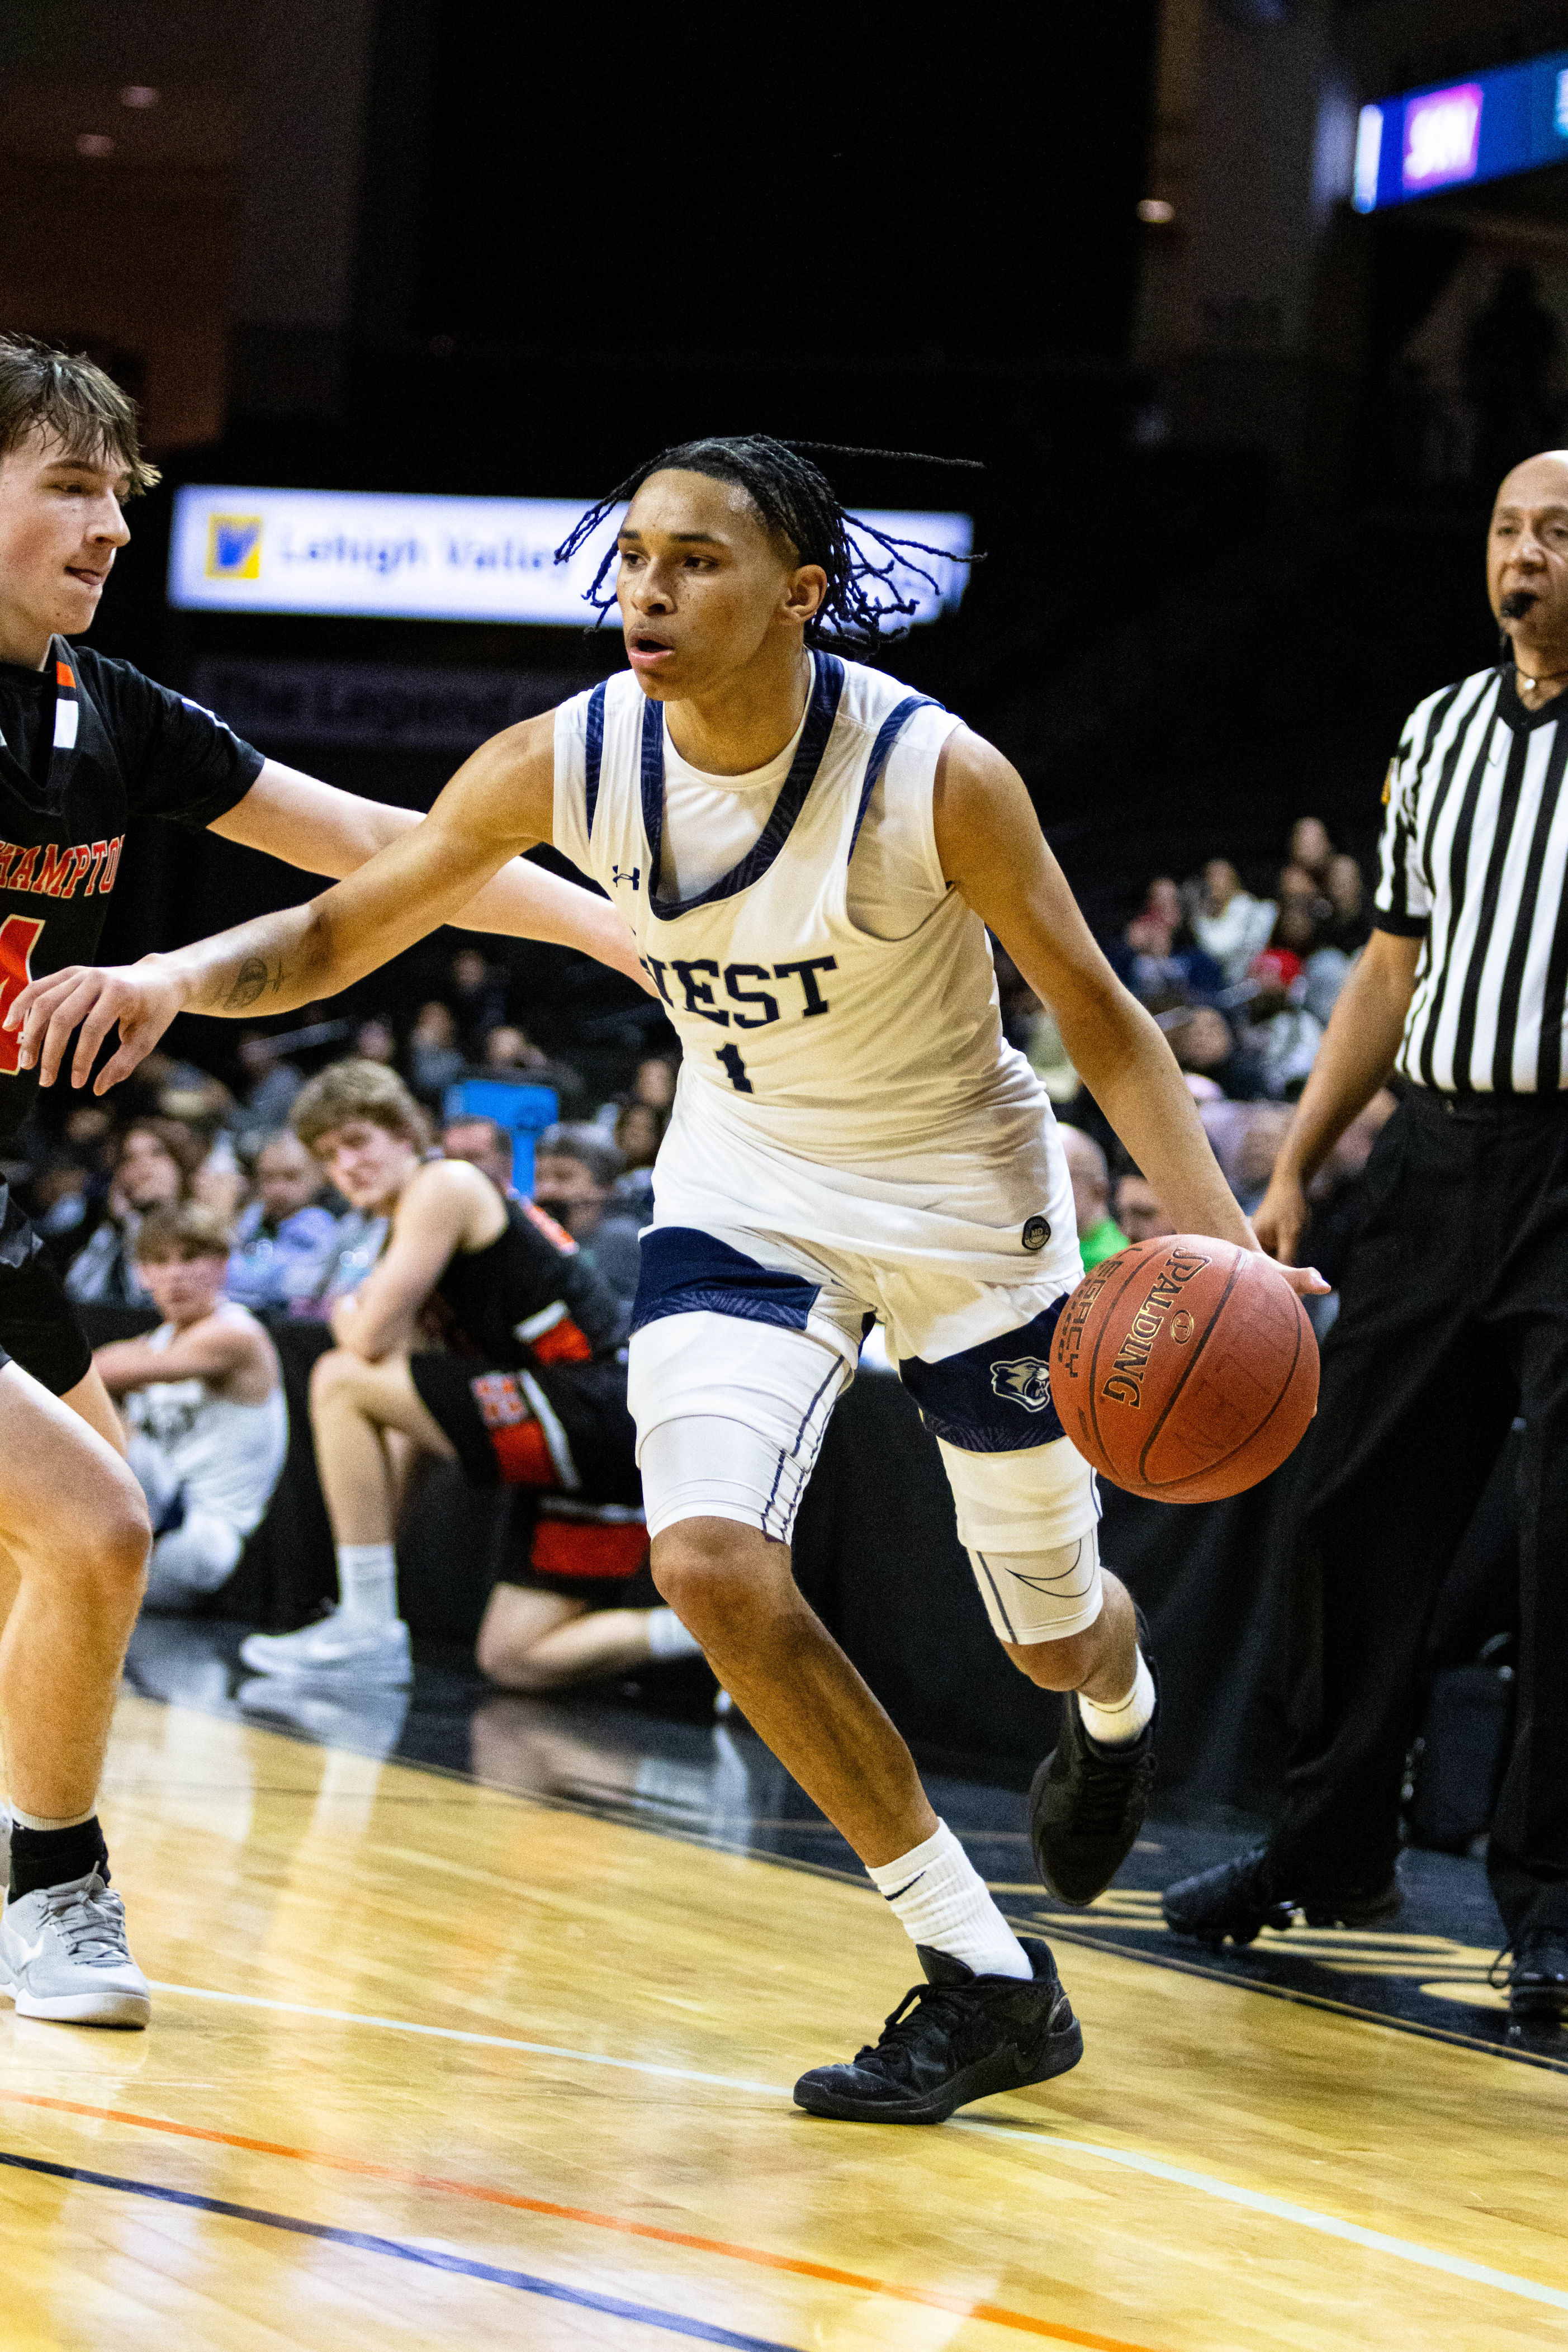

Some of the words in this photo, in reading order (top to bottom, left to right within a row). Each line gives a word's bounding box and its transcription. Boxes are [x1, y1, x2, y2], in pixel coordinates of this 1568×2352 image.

[0, 834, 125, 899] HAMPTO
[714, 1041, 754, 1095] 1
[1065, 1247, 1143, 1378] LEGACY
[1102, 1247, 1212, 1409] SPALDING
